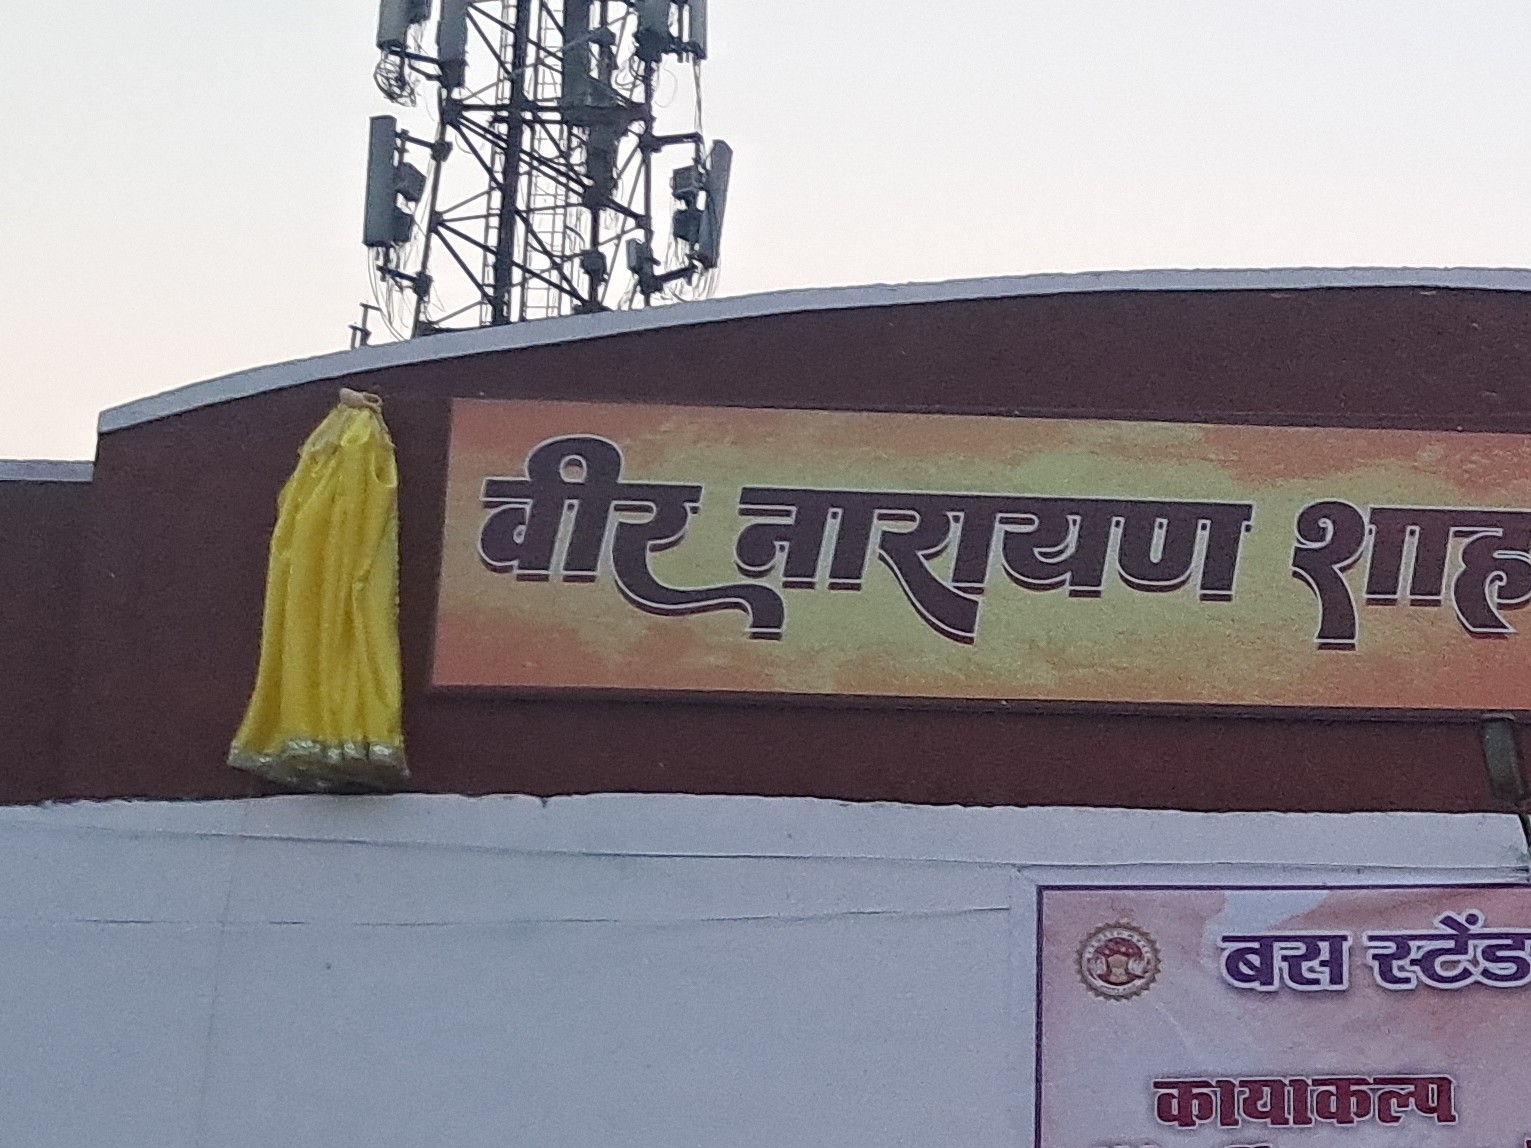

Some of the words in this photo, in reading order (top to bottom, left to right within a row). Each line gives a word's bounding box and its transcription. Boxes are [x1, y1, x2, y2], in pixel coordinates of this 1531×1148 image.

[478, 434, 785, 640] वीर
[735, 487, 1254, 644] नारायण
[1220, 933, 1350, 988] बस
[1153, 1075, 1457, 1128] कायाकल्प
